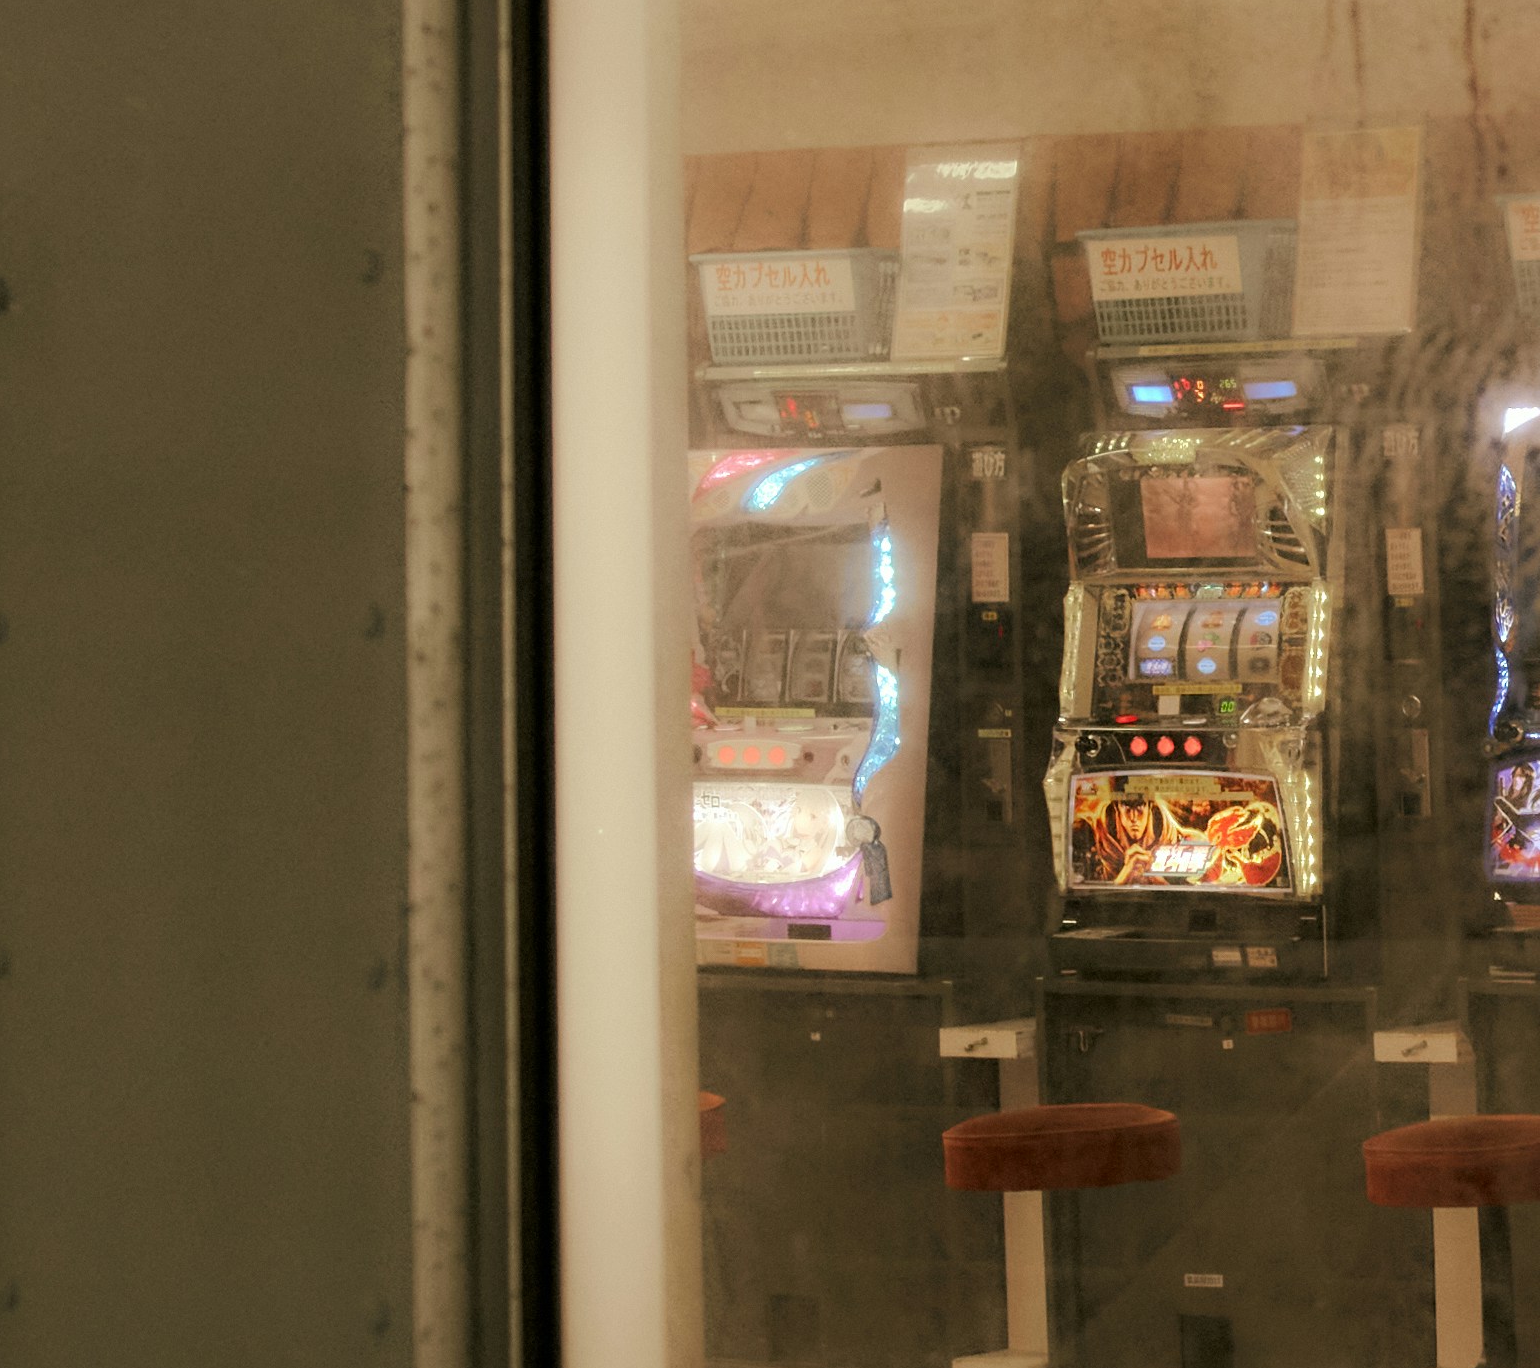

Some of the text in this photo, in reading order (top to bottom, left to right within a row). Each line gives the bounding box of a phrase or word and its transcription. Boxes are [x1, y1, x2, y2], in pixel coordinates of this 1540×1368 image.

[715, 260, 831, 291] 空カプセル入れ
[1101, 243, 1218, 276] 空カプセル入れ
